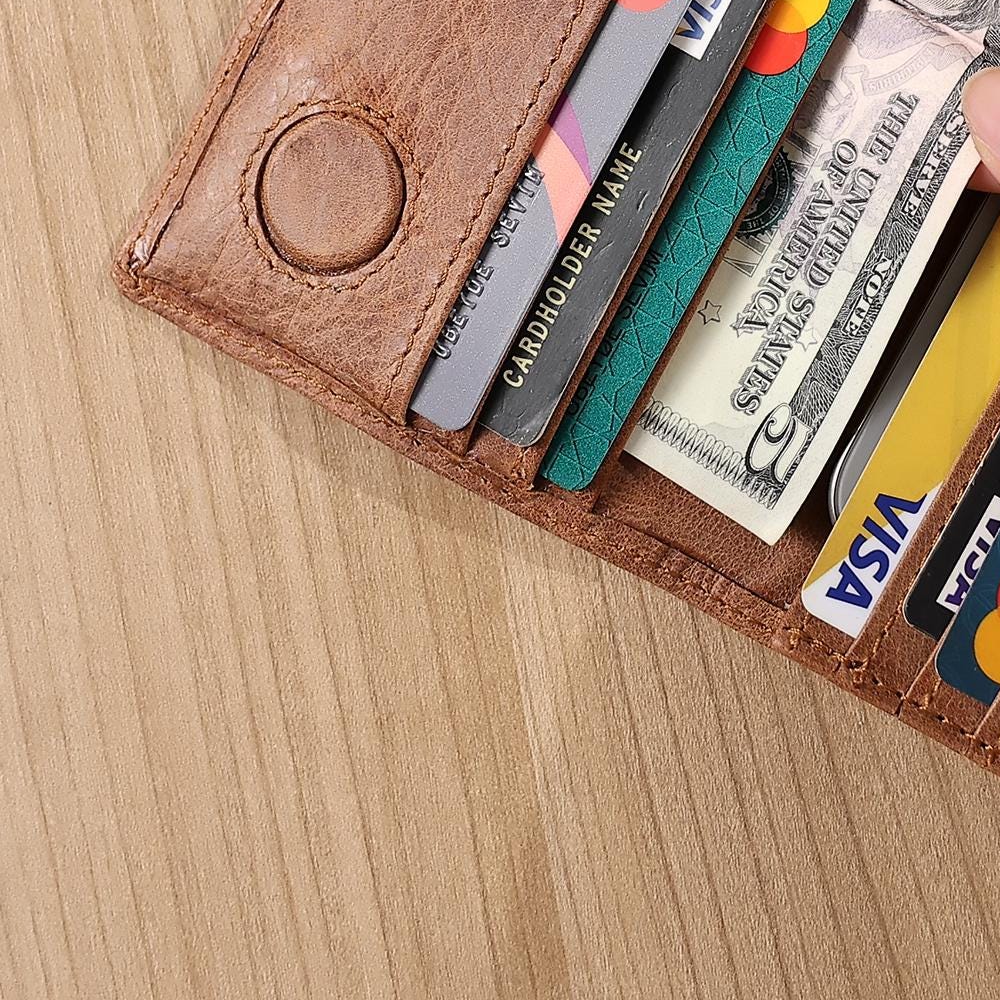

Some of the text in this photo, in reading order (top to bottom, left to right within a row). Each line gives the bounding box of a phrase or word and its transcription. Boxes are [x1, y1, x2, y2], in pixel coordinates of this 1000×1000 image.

[816, 134, 862, 194] OF
[860, 92, 920, 167] THE
[499, 140, 643, 390] CARDHOLDER NAME
[736, 179, 839, 339] AMERICA
[797, 162, 882, 295] UNITED
[839, 105, 968, 338] SERVE NOTE
[727, 288, 818, 420] STATES
[737, 396, 814, 490] 5
[825, 492, 927, 606] VISA
